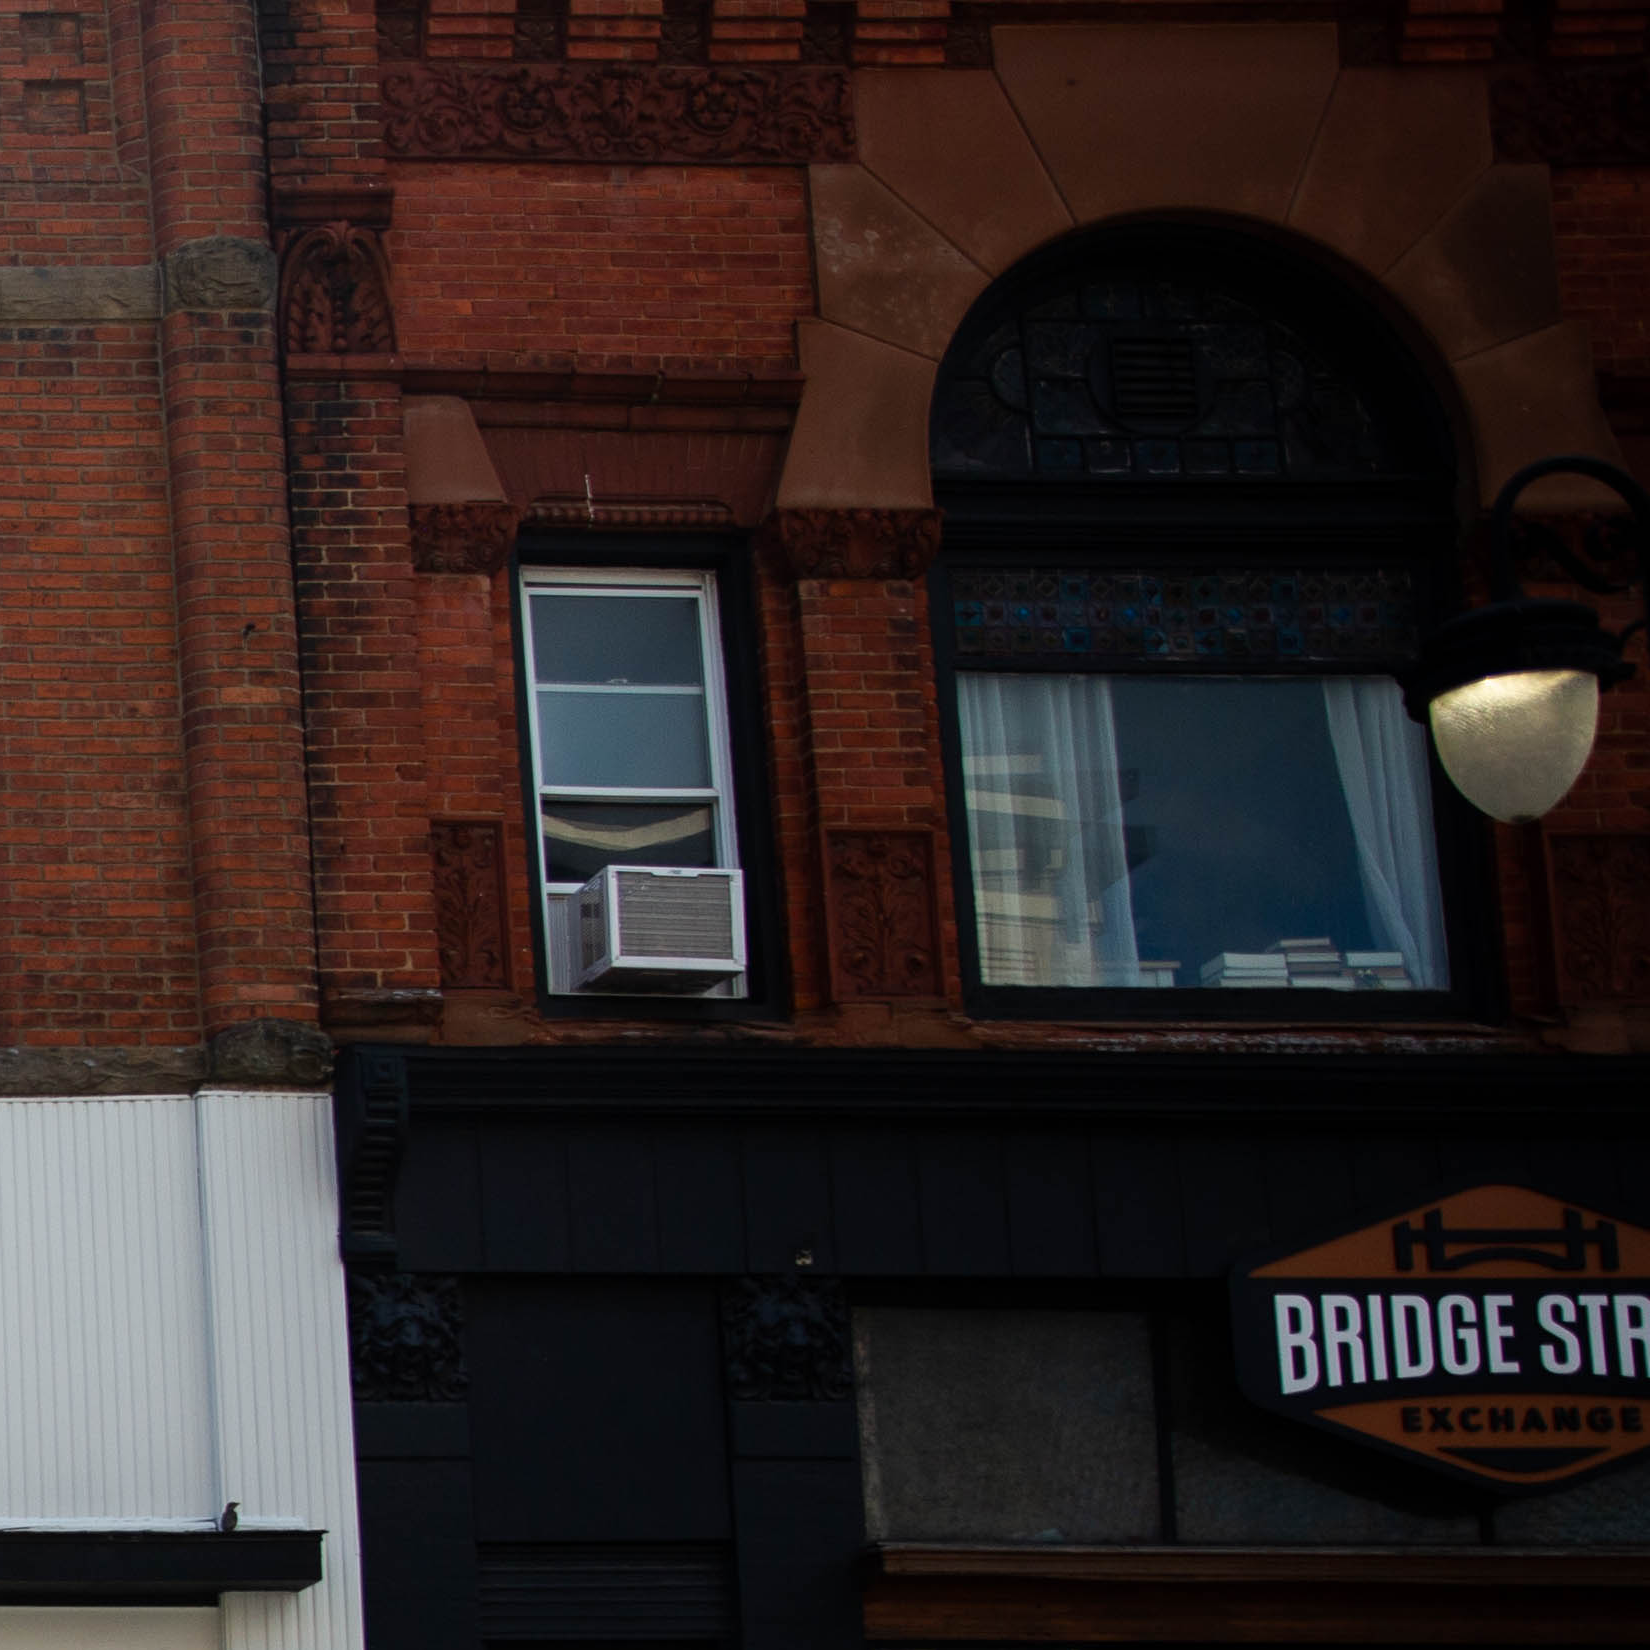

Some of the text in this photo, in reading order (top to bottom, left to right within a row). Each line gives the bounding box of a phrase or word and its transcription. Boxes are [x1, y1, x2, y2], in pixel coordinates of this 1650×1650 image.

[1273, 1293, 1650, 1397] BRIDGE STR
[1401, 1406, 1643, 1434] EXCHANGE
